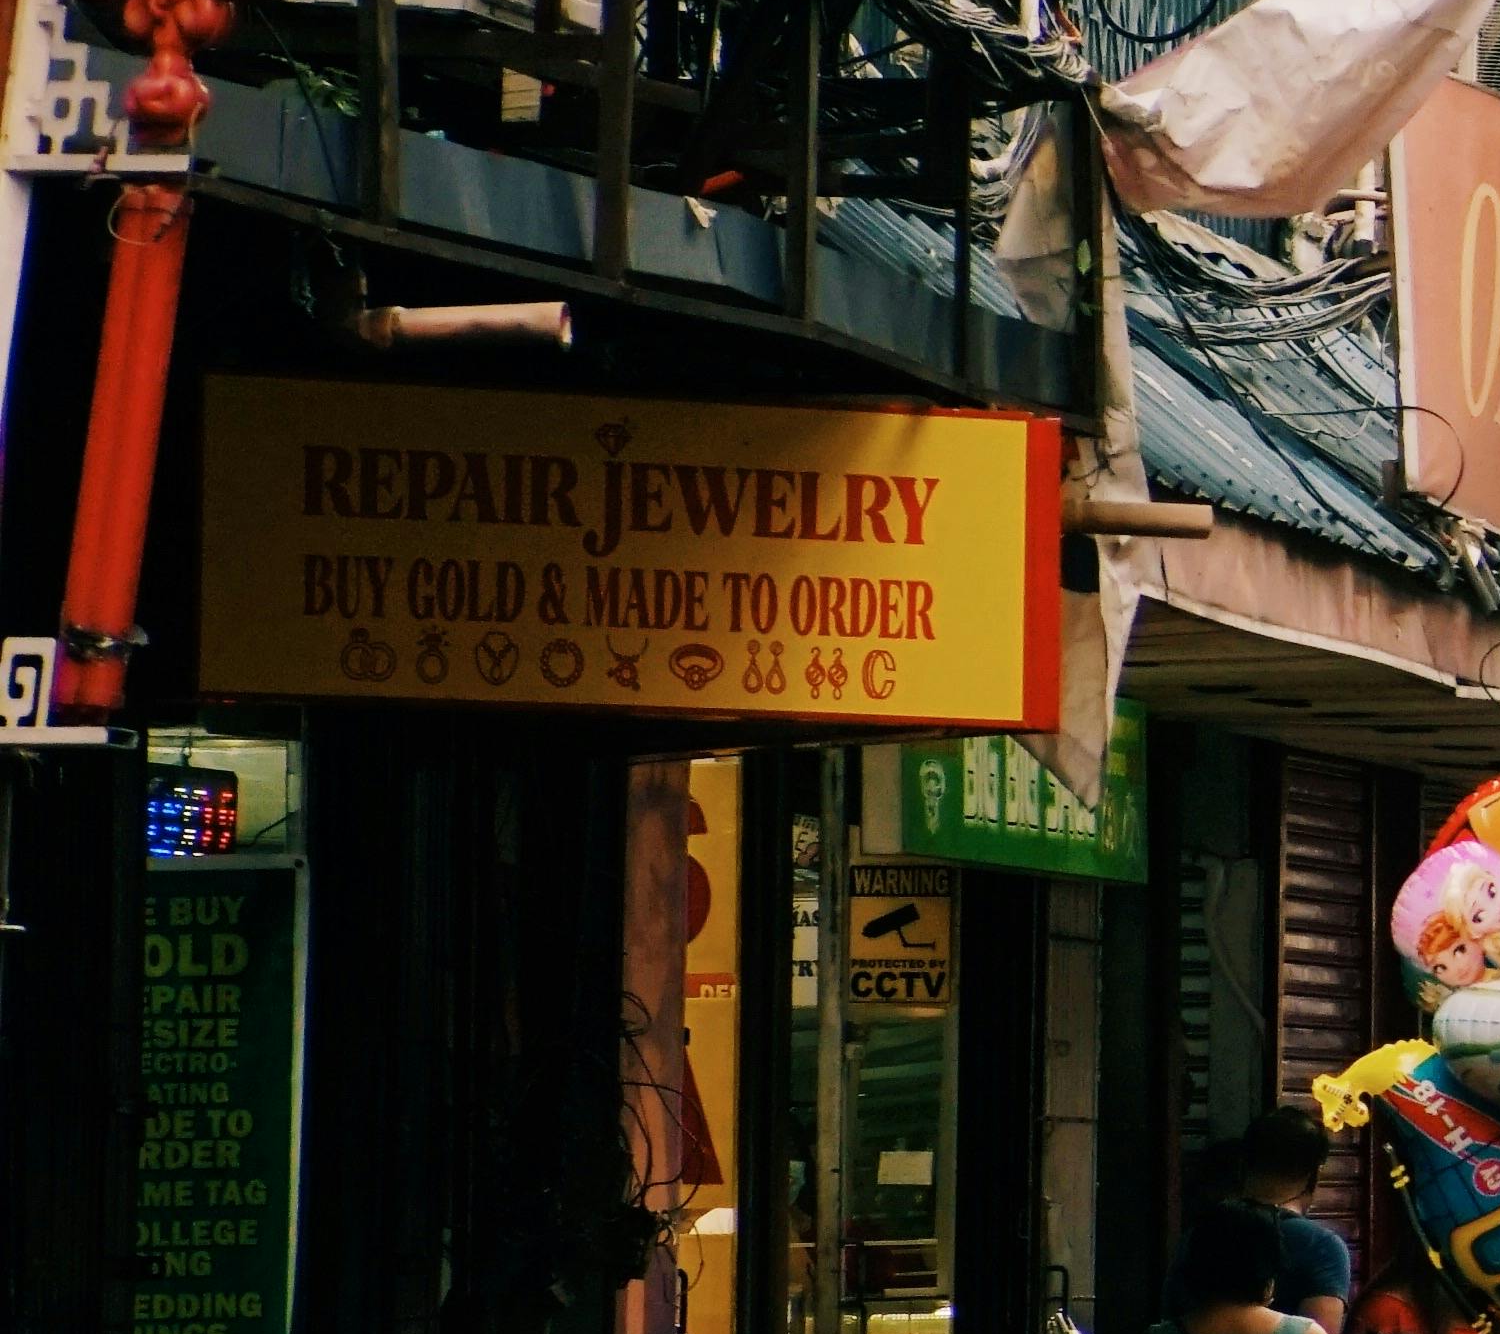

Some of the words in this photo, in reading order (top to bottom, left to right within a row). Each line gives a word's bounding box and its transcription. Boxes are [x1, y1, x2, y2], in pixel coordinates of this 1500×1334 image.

[302, 444, 583, 528] REPAIR
[583, 460, 939, 557] JEWELRY
[304, 554, 395, 618] BUY
[408, 558, 525, 622] GOLD
[537, 562, 570, 626] &
[583, 565, 710, 632] MADE
[722, 572, 779, 635] TO
[789, 574, 936, 641] ORDER
[851, 867, 951, 894] WARNING
[168, 895, 245, 926] BUY
[144, 933, 249, 978] OLD
[851, 959, 926, 968] PROTECTED
[929, 959, 946, 968] BY
[850, 970, 946, 998] CCTV
[143, 984, 241, 1015] PAIR
[142, 1018, 239, 1048] SIZE
[145, 1081, 229, 1105] ATING
[146, 1108, 196, 1139] DE
[207, 1108, 254, 1138] TO
[138, 1140, 241, 1170] RDER
[207, 1178, 267, 1208] TAG
[133, 1291, 263, 1319] EDDING
